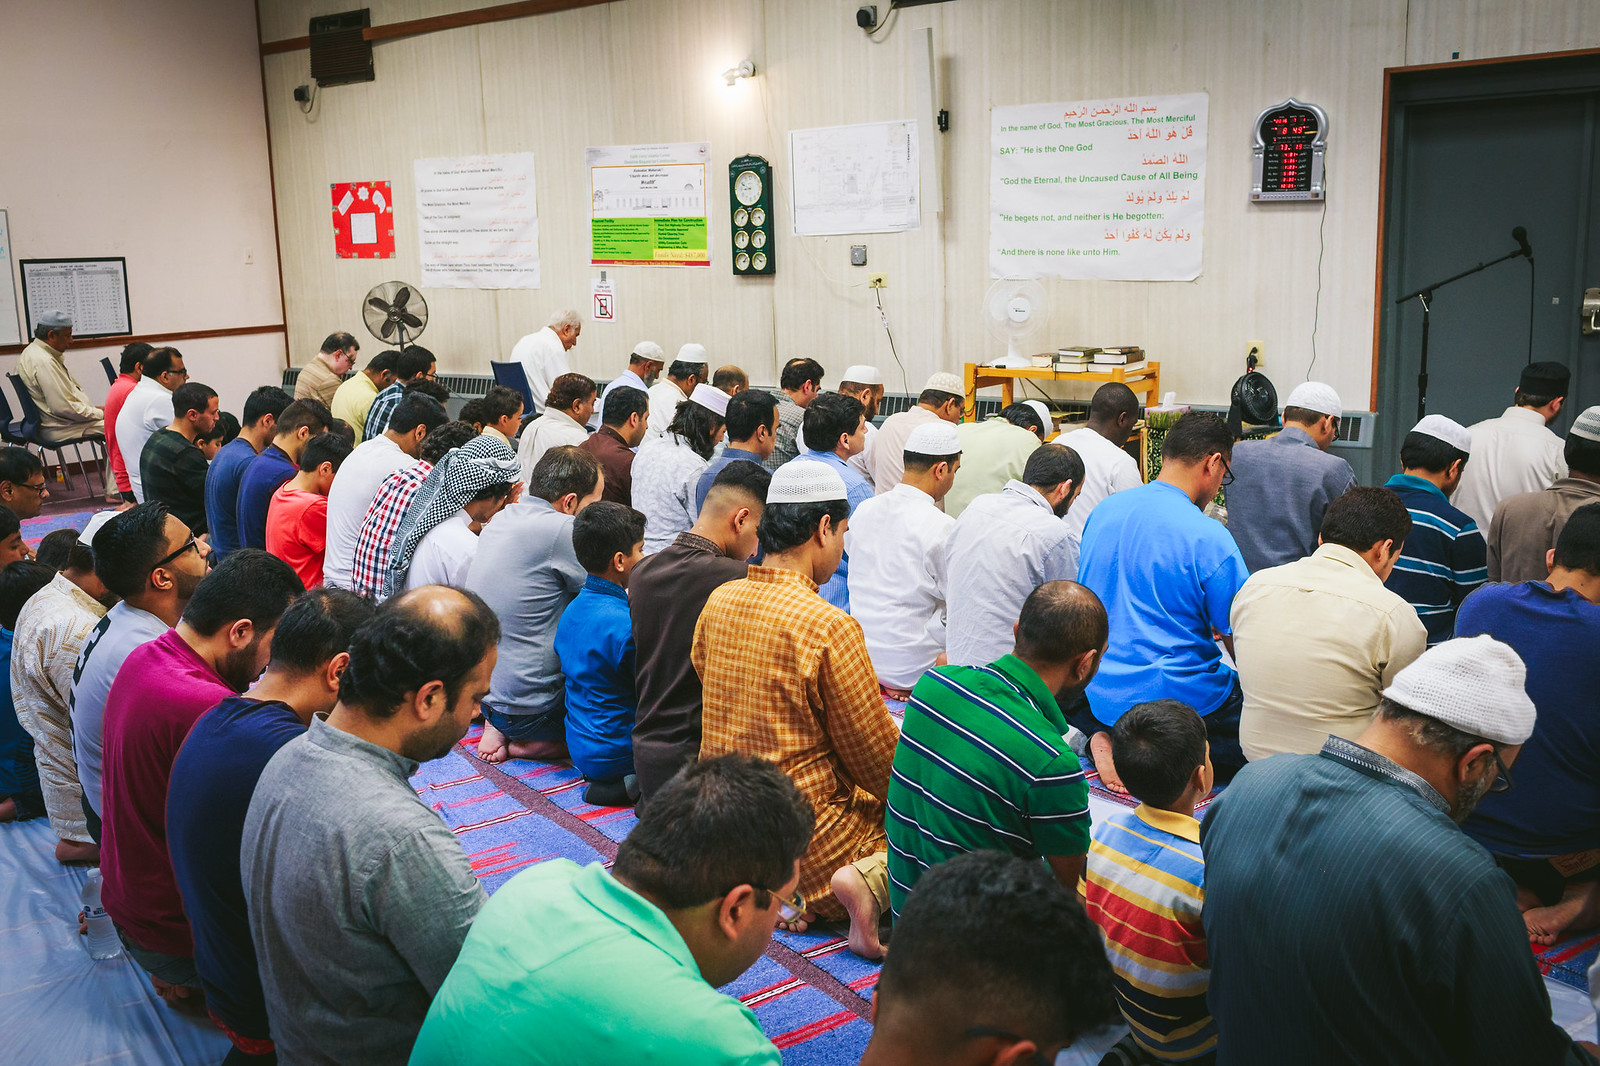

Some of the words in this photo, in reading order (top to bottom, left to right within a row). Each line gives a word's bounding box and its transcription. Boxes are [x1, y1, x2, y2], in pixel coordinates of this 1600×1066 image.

[1078, 120, 1095, 128] Most
[1146, 116, 1164, 124] Most
[1166, 114, 1196, 122] Merciful
[1000, 147, 1018, 155] SAY:
[1044, 145, 1057, 153] the
[1058, 144, 1074, 152] One
[1076, 144, 1093, 152] God
[1034, 176, 1062, 184] Eternal,
[1079, 174, 1118, 182] Uncaused
[1148, 172, 1157, 180] of
[1159, 172, 1170, 180] All
[1173, 171, 1198, 180] Being
[1014, 215, 1039, 223] begets
[1074, 213, 1101, 221] neither
[1017, 248, 1036, 256] there
[1038, 248, 1044, 256] is
[1067, 248, 1080, 256] like
[1103, 248, 1120, 256] Him.
